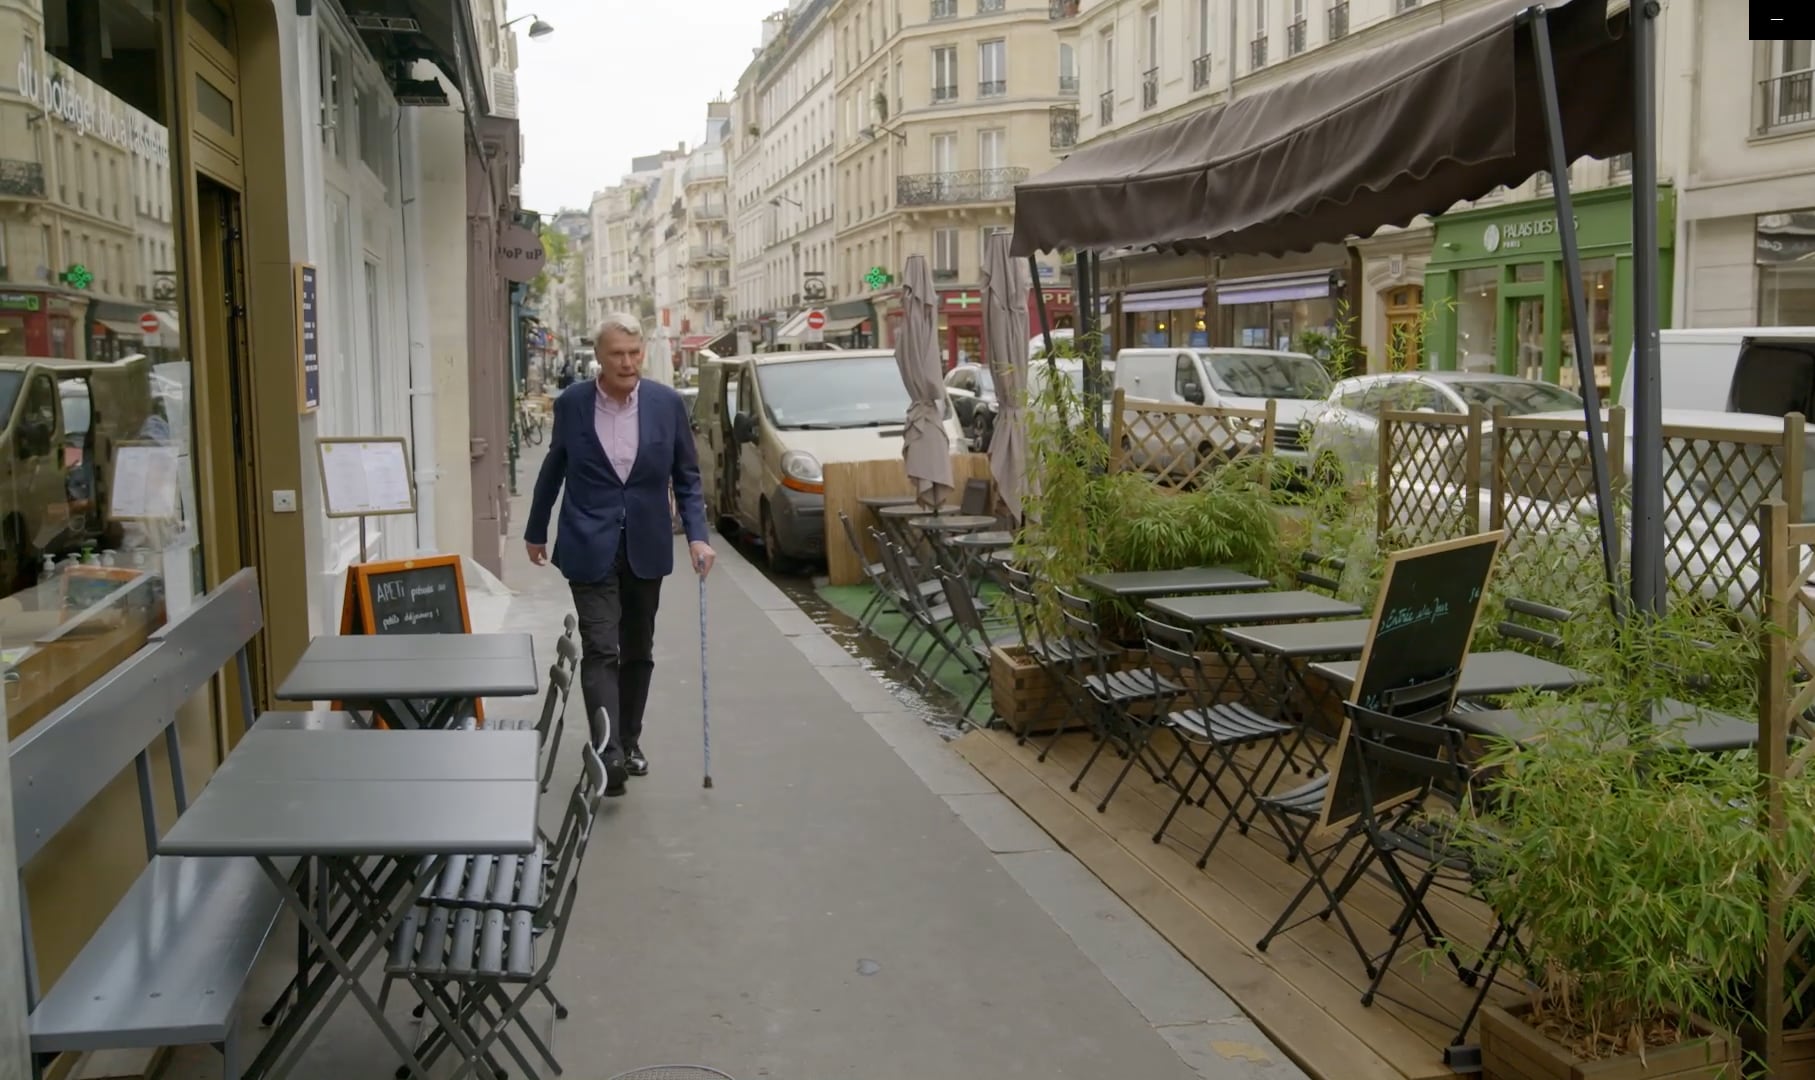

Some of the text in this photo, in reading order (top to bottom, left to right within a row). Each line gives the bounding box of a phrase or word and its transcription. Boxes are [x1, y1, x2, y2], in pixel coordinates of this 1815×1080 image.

[18, 50, 38, 102] du
[44, 76, 96, 136] potager
[1503, 221, 1533, 238] PALAIS
[1534, 219, 1553, 235] DES
